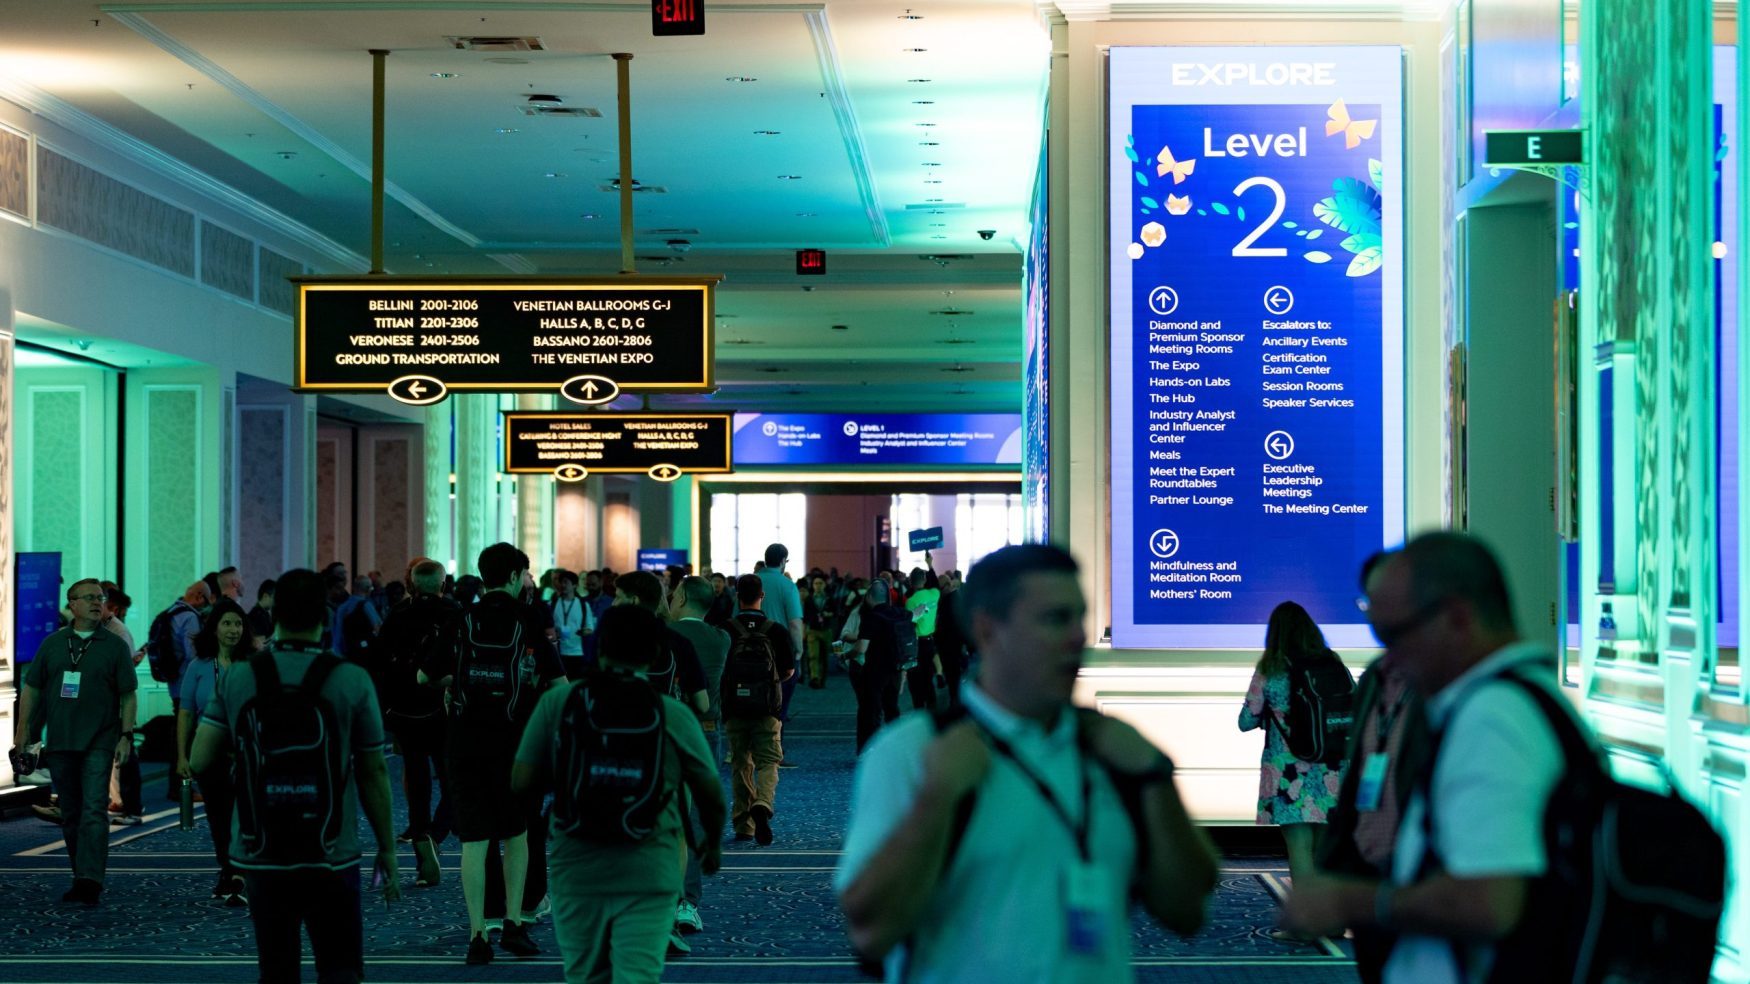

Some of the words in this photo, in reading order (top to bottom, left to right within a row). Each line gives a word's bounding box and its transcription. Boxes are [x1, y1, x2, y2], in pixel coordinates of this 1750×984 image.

[663, 0, 694, 22] EXIT
[1172, 63, 1337, 86] EXPLORE
[1203, 127, 1307, 157] Level
[1527, 137, 1542, 159] E
[1232, 176, 1288, 257] 2
[802, 252, 821, 267] EXIT
[369, 300, 414, 311] BELLINI
[420, 300, 478, 310] 2001-2106
[513, 301, 573, 311] VENETIAN
[576, 300, 650, 311] BALLROOMS
[652, 300, 671, 310] G-J
[374, 317, 414, 328] TITIAN
[420, 317, 479, 328] 2201-2306
[540, 318, 578, 329] HALLS
[579, 318, 592, 330] A,
[594, 318, 605, 330] B,
[607, 318, 619, 330] C,
[622, 318, 633, 330] D,
[635, 317, 645, 328] G
[1149, 320, 1198, 330] Diamond
[1200, 320, 1221, 330] and
[1263, 320, 1316, 330] Escalators
[1317, 320, 1331, 329] to:
[349, 335, 414, 346] VERONESE
[420, 335, 480, 346] 2401-2506
[533, 335, 590, 346] BASSANO
[592, 335, 652, 346] 2601-2806
[1149, 332, 1198, 342] Premium
[1200, 332, 1245, 343] Sponsor
[1262, 337, 1309, 348] Ancillary
[1311, 336, 1348, 346] Events
[1149, 344, 1193, 355] Meeting
[1196, 344, 1233, 353] Rooms
[335, 354, 390, 365] GROUND
[392, 353, 500, 364] TRANSPORTATION
[531, 353, 555, 364] THE
[557, 353, 618, 364] VENETIAN
[620, 353, 654, 363] EXPO
[1262, 353, 1327, 362] Certification
[1149, 361, 1170, 370] The
[1172, 360, 1200, 372] Expo
[1263, 365, 1292, 374] Exam
[1295, 365, 1331, 374] Center
[1150, 377, 1202, 387] Hands-on
[1205, 377, 1231, 386] Labs
[1262, 381, 1304, 391] Session
[1306, 381, 1344, 391] Rooms
[1149, 393, 1170, 403] The
[1172, 394, 1195, 403] Hub
[1263, 398, 1307, 409] Speaker
[1309, 398, 1354, 407] Services
[1150, 410, 1194, 421] Industry
[1196, 410, 1235, 421] Analyst
[623, 422, 657, 430] VENETIAN
[657, 422, 697, 430] BALLROOMS
[778, 424, 789, 432] The
[790, 424, 805, 432] Expo
[860, 424, 880, 432] LEVEL
[1149, 422, 1170, 431] and
[1173, 422, 1226, 431] Influencer
[552, 432, 558, 440] &
[558, 432, 601, 440] CONFERENCE
[602, 432, 622, 440] MGMT
[637, 432, 658, 440] HALLS
[860, 432, 887, 440] Diamond
[899, 432, 925, 440] Premium
[925, 432, 950, 440] Sponsor
[950, 432, 974, 440] Meeting
[974, 432, 995, 440] Rooms
[1149, 434, 1185, 443] Center
[537, 442, 572, 450] VERONESE
[633, 441, 647, 449] THE
[647, 441, 680, 450] VENETIAN
[680, 441, 699, 449] EXPO
[860, 440, 884, 448] Industry
[884, 440, 906, 448] Analyst
[860, 447, 878, 455] Meals
[1150, 450, 1181, 460] Meals
[1150, 467, 1177, 476] Meet
[1179, 467, 1197, 476] the
[1200, 466, 1235, 477] Expert
[1263, 464, 1315, 473] Executive
[1150, 478, 1217, 488] Roundtables
[1263, 476, 1323, 486] Leadership
[1263, 487, 1312, 499] Meetings
[1150, 495, 1190, 504] Partner
[1193, 495, 1234, 506] Lounge
[1263, 504, 1284, 513] The
[1286, 504, 1329, 515] Meeting
[1332, 504, 1368, 513] Center
[911, 535, 940, 545] EXPLORE
[1150, 560, 1214, 570] Mindfulness
[1216, 561, 1237, 570] and
[1150, 573, 1207, 582] Meditation
[1210, 573, 1241, 582] Room
[1200, 589, 1232, 599] Room
[469, 669, 505, 679] EXPLORE
[589, 764, 643, 779] EXPLORE
[265, 783, 318, 795] EXPLORE
